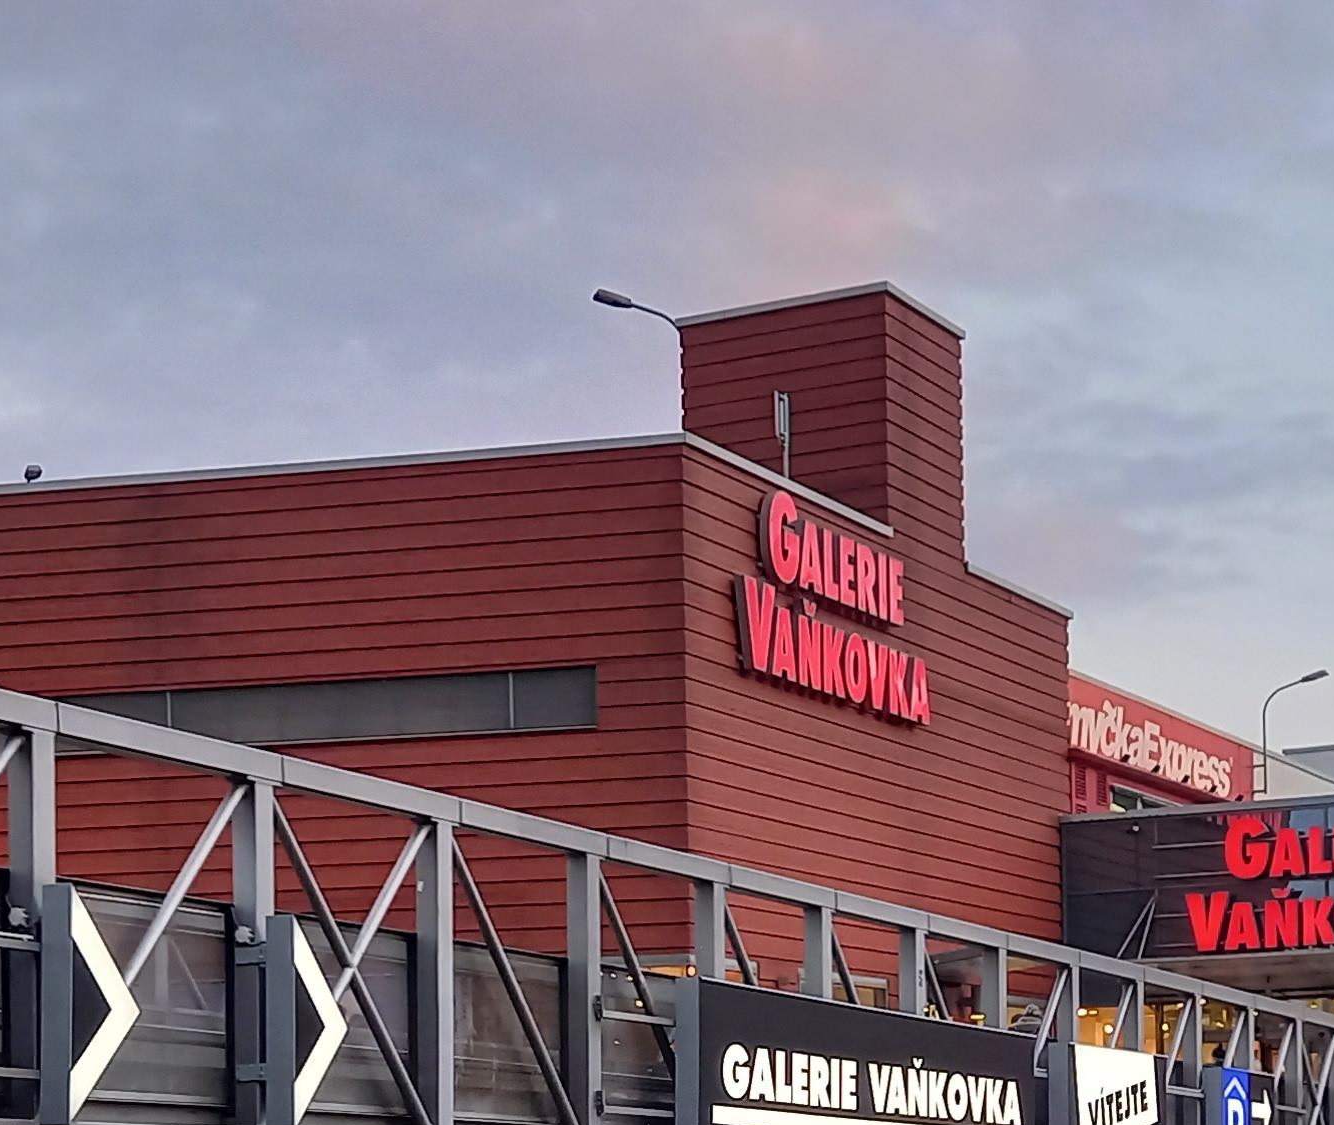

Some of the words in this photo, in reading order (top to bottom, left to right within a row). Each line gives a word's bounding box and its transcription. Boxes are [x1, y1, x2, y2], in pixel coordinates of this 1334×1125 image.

[762, 490, 904, 627] GALERIE
[737, 574, 931, 727] VAŇKOVKA
[721, 1042, 858, 1111] GALERIE
